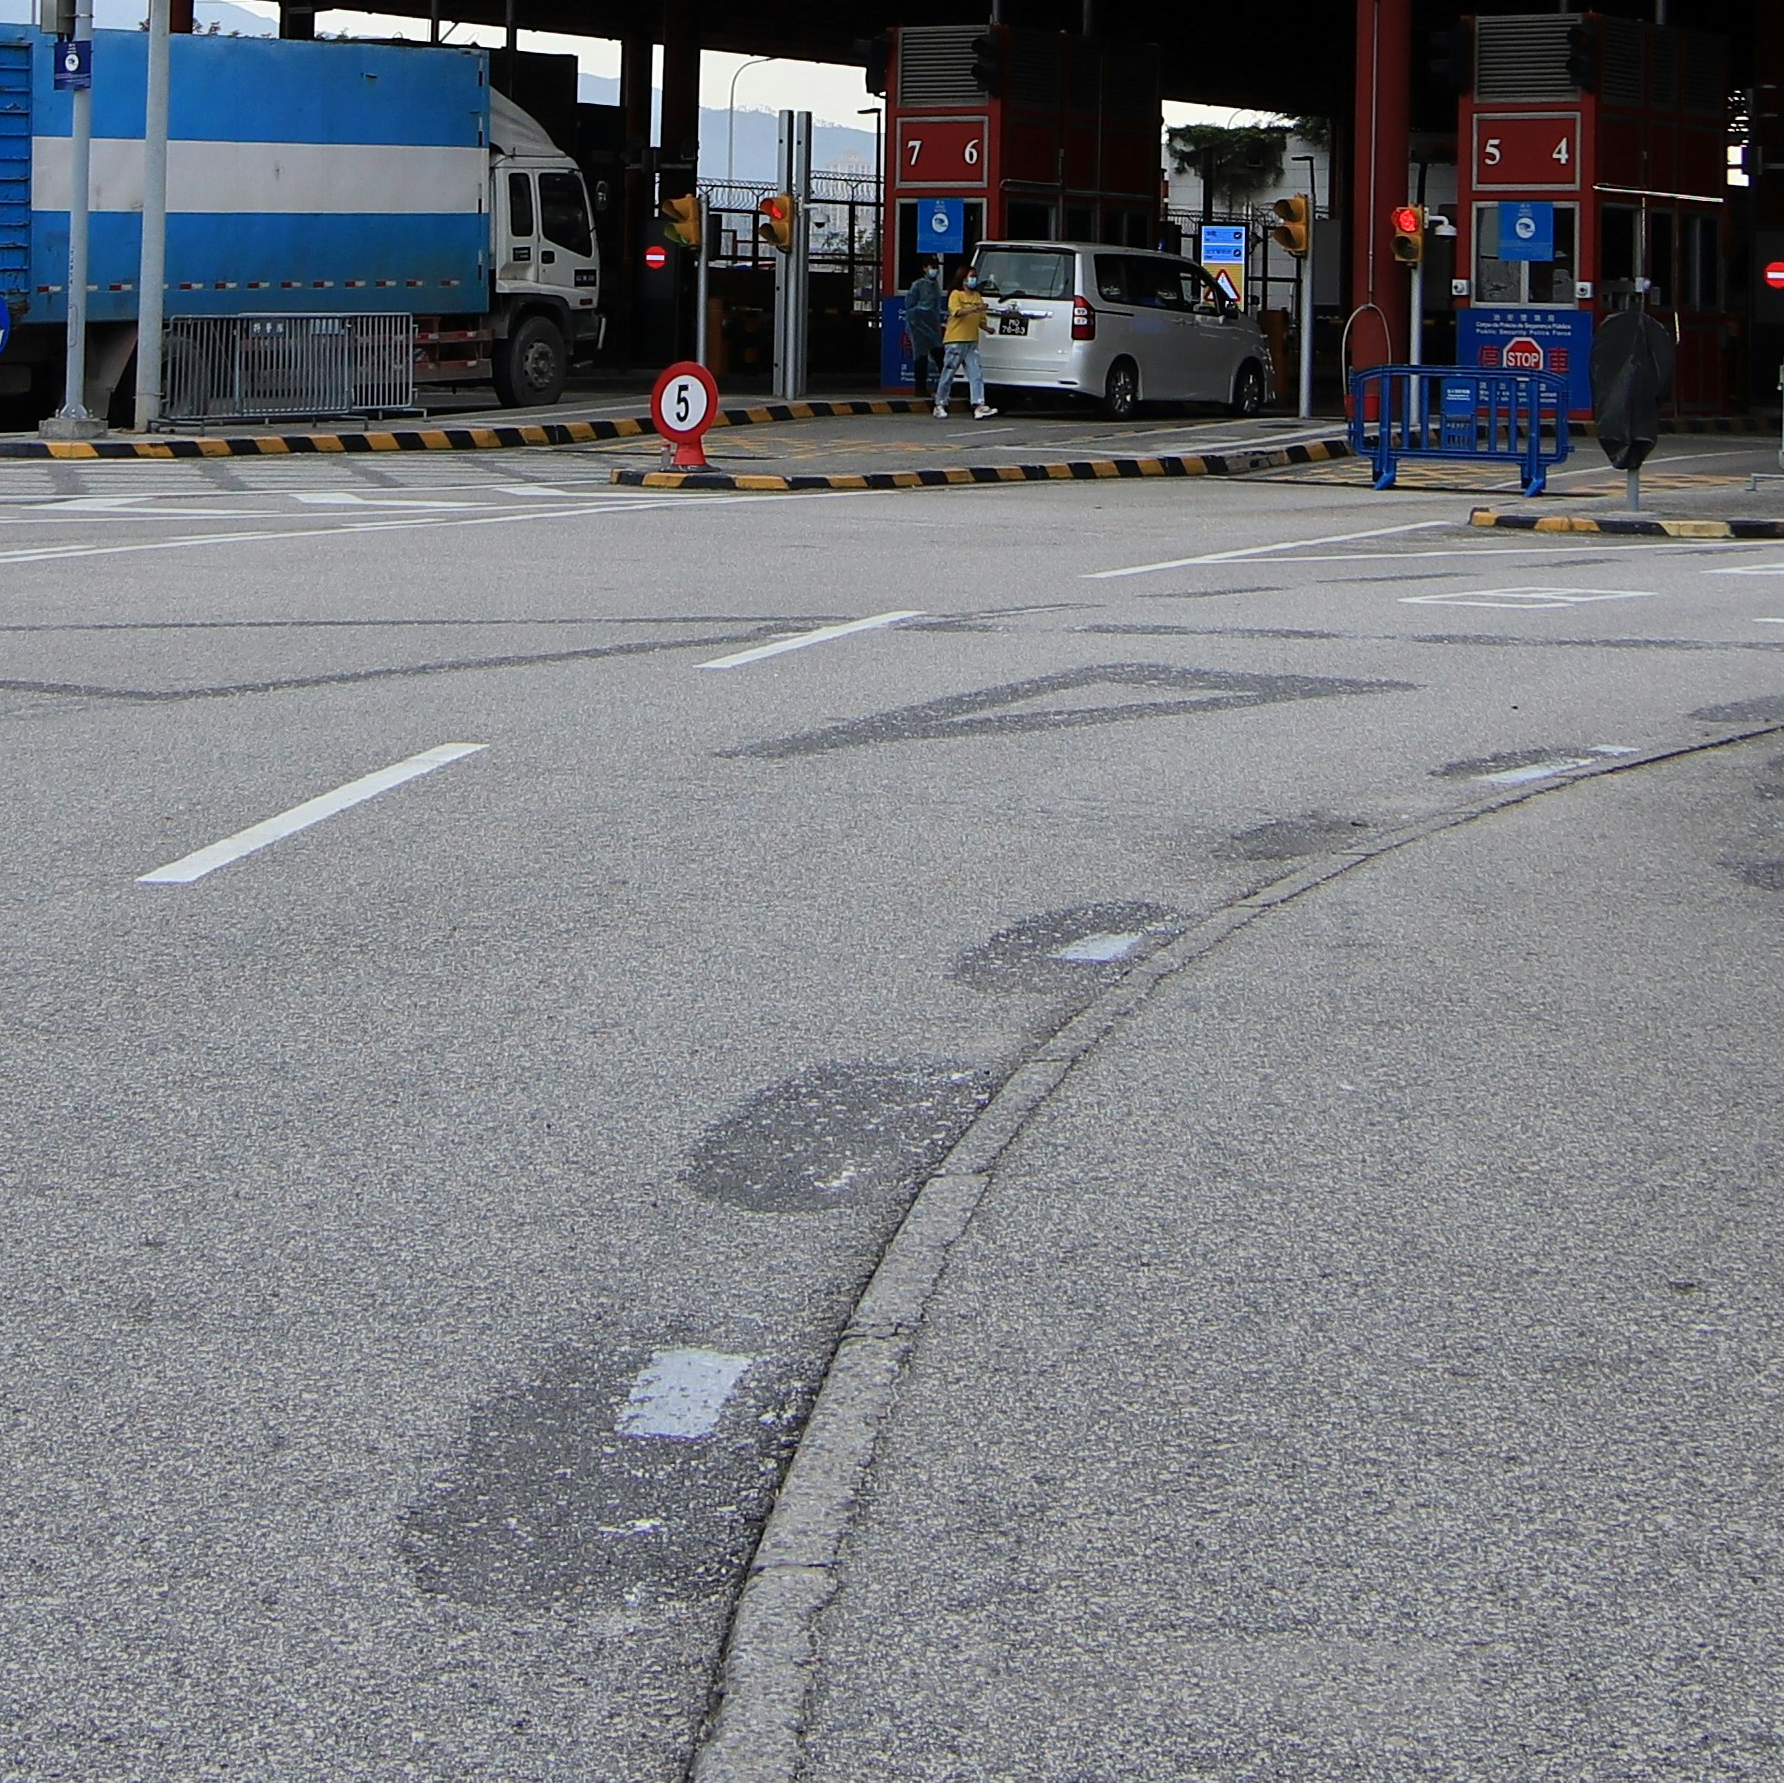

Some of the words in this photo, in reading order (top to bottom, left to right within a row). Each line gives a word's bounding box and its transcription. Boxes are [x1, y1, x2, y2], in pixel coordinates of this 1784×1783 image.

[907, 140, 922, 166] 7
[964, 139, 979, 165] 6
[1484, 139, 1501, 165] 5
[1552, 137, 1569, 164] 4
[1507, 352, 1539, 367] STOP
[676, 384, 689, 422] 5
